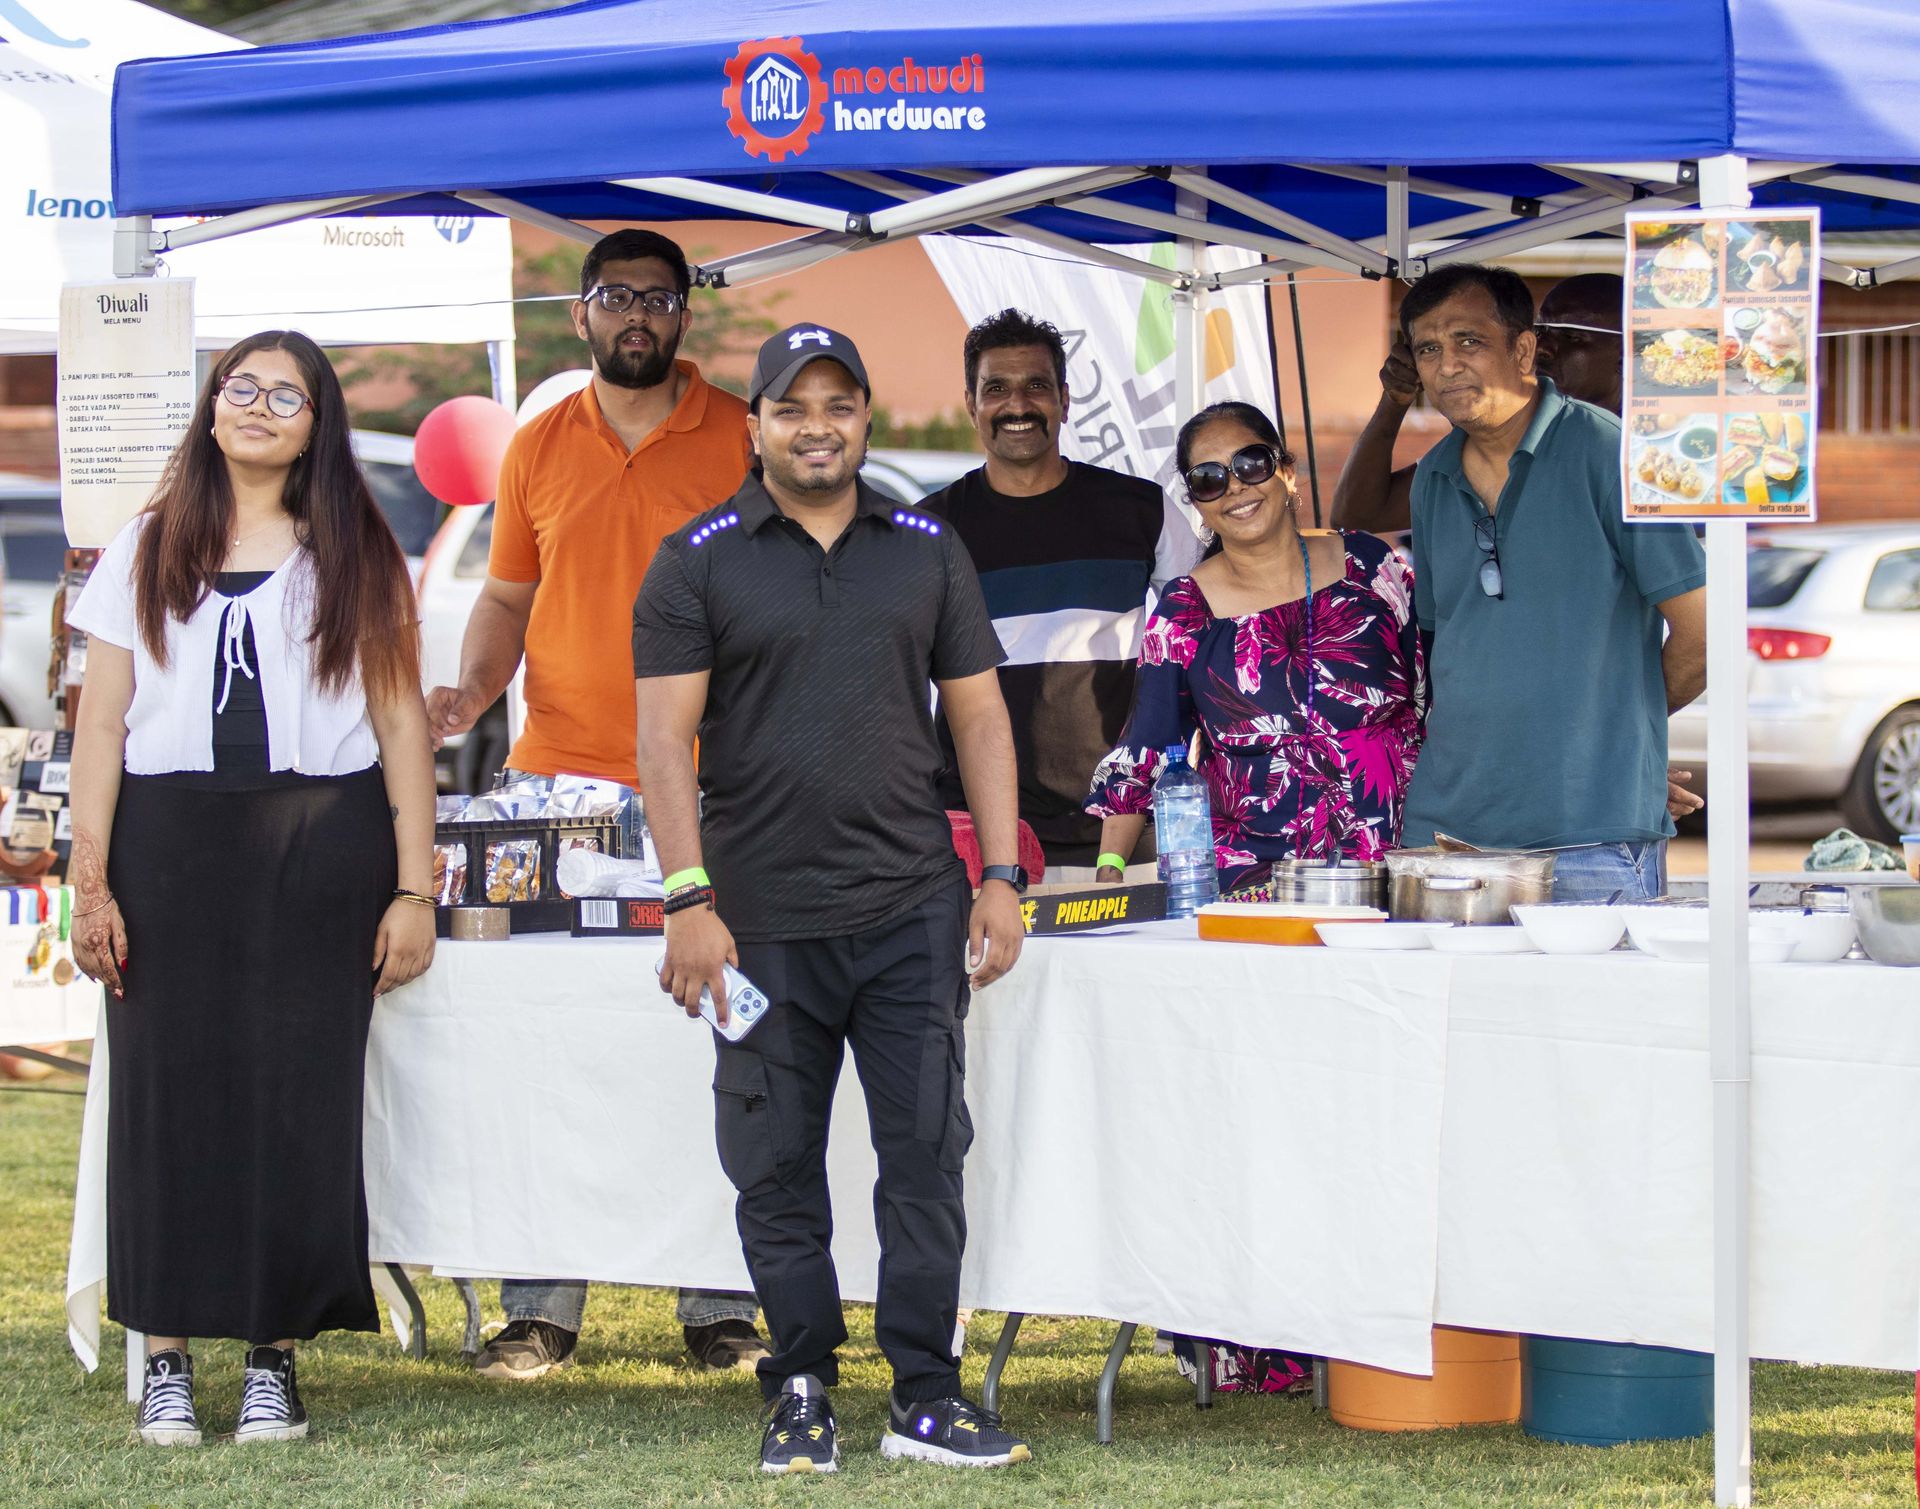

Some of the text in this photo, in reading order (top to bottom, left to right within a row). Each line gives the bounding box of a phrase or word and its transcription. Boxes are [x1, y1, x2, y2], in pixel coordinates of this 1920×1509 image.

[833, 53, 985, 94] mochudi
[834, 100, 986, 132] hardware
[323, 226, 404, 248] Microsoft
[96, 292, 148, 314] Diwali
[1634, 504, 1647, 513] Pani
[1056, 896, 1128, 925] PINEAPPLE
